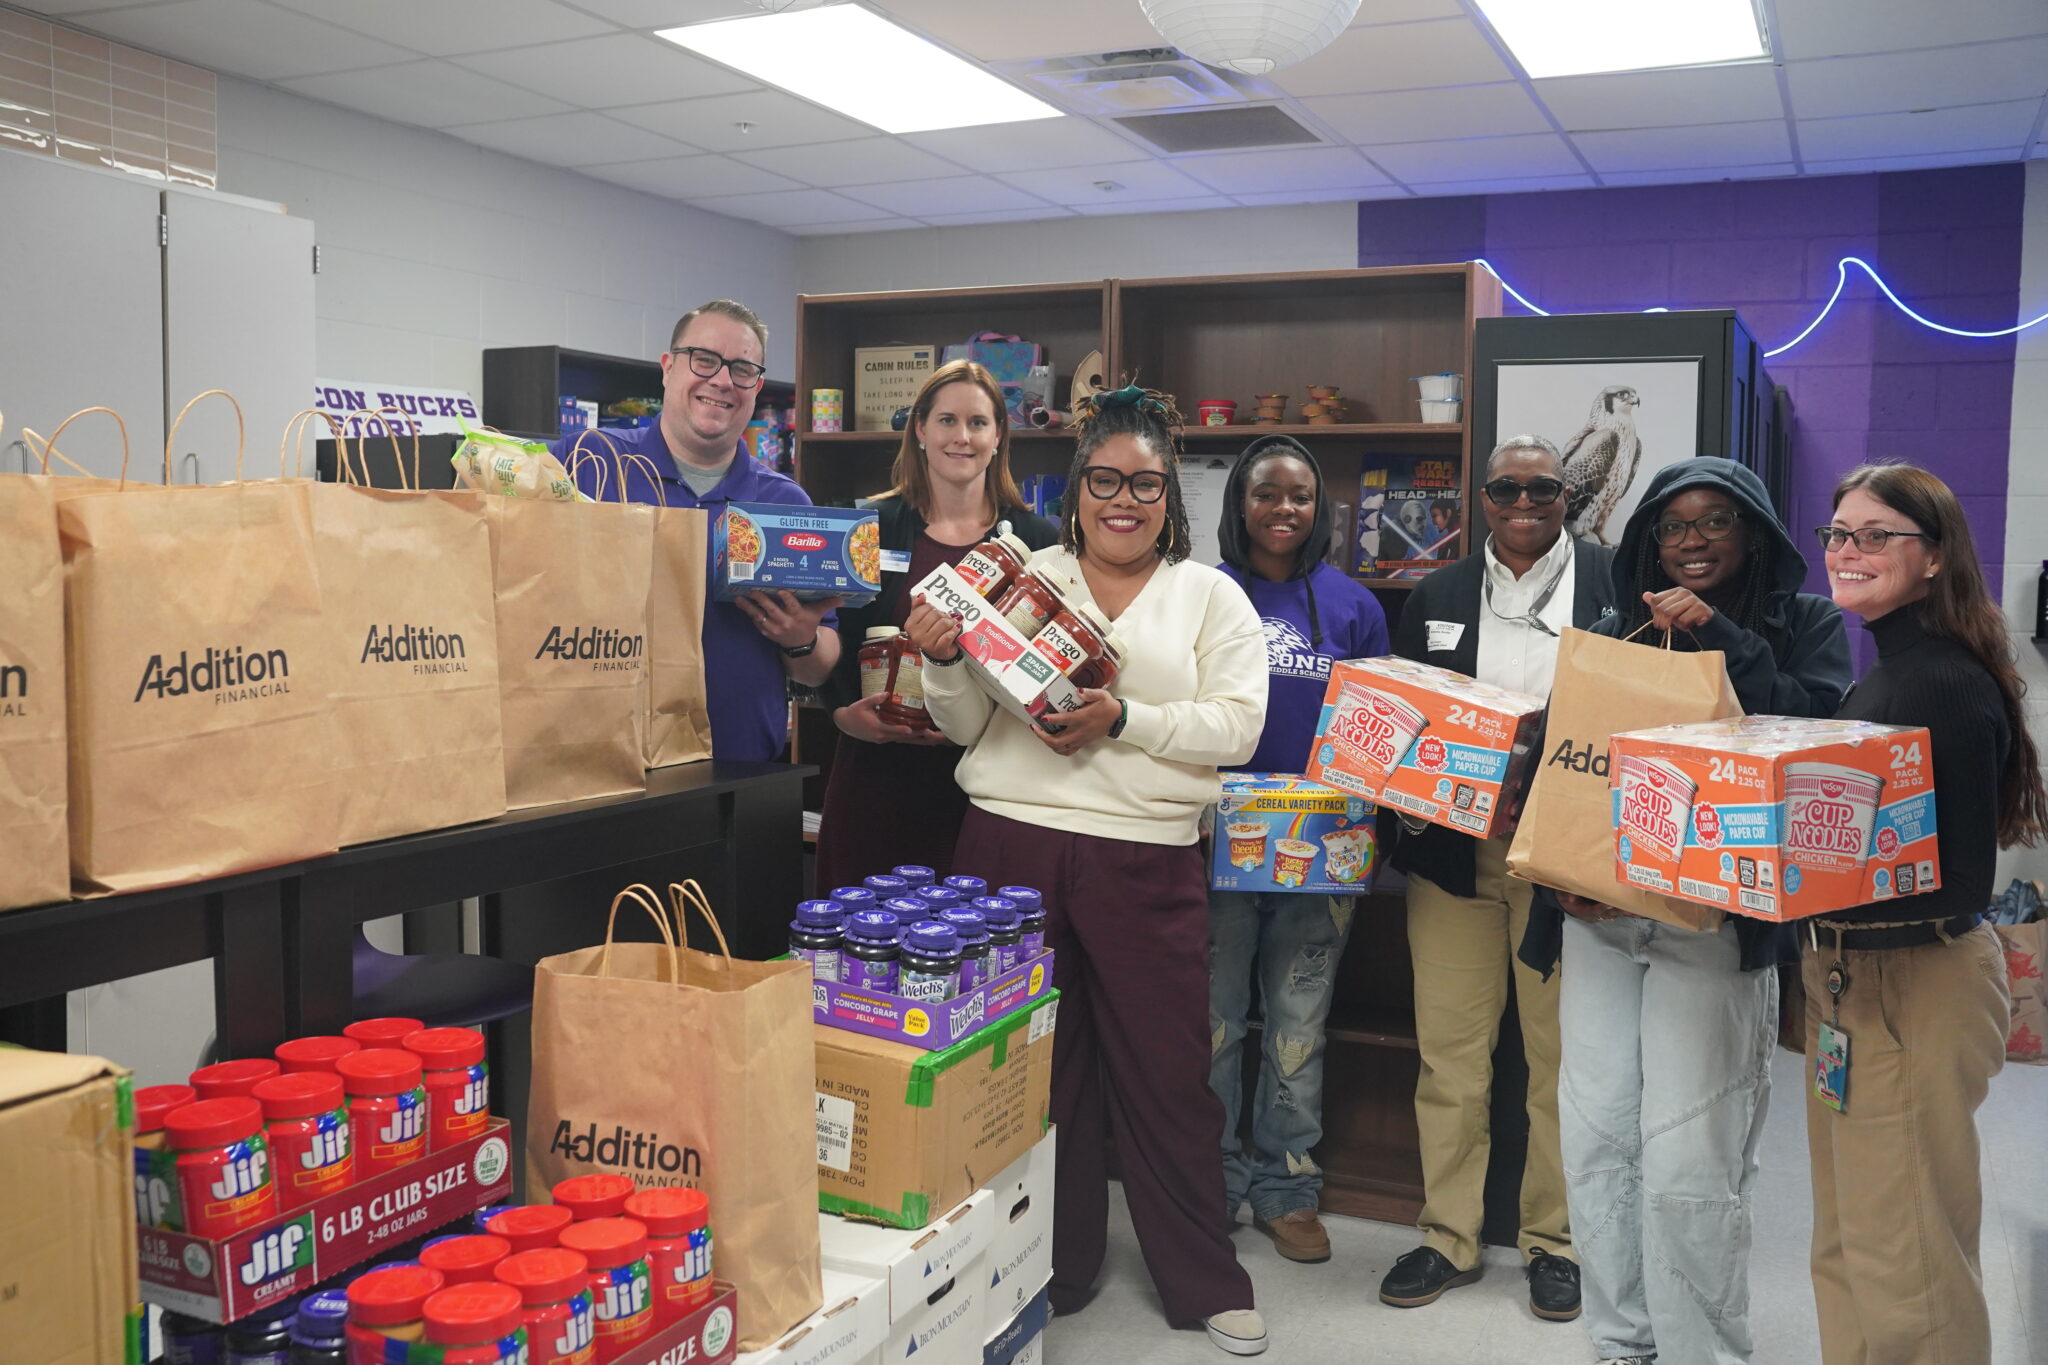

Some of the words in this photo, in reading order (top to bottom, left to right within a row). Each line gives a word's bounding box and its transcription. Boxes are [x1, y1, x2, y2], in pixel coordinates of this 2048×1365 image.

[897, 360, 929, 371] RULES
[377, 392, 477, 419] BUCKS
[1388, 490, 1427, 500] HEAD
[1437, 490, 1462, 500] HEA
[1412, 479, 1456, 488] REBELS
[780, 517, 809, 528] GLUTEN
[812, 519, 829, 529] FREE
[788, 536, 823, 547] Barilla
[799, 554, 809, 568] 4
[961, 553, 997, 578] Prego
[924, 573, 981, 622] Prego
[360, 624, 466, 664] Addition
[535, 625, 643, 661] Addition
[984, 625, 1017, 652] Traditional
[1042, 625, 1081, 660] Prego
[134, 645, 289, 703] Addition
[413, 661, 469, 676] FINANCIAL
[593, 660, 641, 673] FINANCIAL
[1299, 668, 1330, 680] SCHOOL
[214, 681, 291, 706] FINANCIAL
[1351, 707, 1395, 741] CUP
[1445, 704, 1478, 730] 24
[1480, 716, 1503, 729] PACK
[1330, 714, 1396, 766] NOODLES
[1477, 725, 1494, 736] 2.25
[1494, 729, 1508, 740] OZ
[1332, 737, 1369, 764] CHICKEN
[1421, 751, 1442, 762] LOOK!
[1424, 743, 1441, 753] NEW
[1451, 749, 1502, 767] MICROWAVABLE
[1889, 741, 1923, 770] 24
[1454, 760, 1479, 774] PAPER
[1480, 764, 1497, 777] CUP
[1708, 756, 1737, 785] 24
[1737, 764, 1759, 777] PACK
[1895, 767, 1920, 779] PACK
[1737, 776, 1754, 788] 2.25
[1754, 778, 1767, 790] OZ
[1822, 782, 1844, 793] NISSIN
[1892, 778, 1910, 789] 2.25
[1911, 776, 1924, 786] OZ
[1256, 798, 1288, 810] CEREAL
[1288, 799, 1323, 811] VARIETY
[1324, 799, 1346, 811] PACK
[1350, 801, 1362, 812] 12
[1635, 782, 1673, 818] CUP
[1622, 795, 1678, 848] NOODLES
[1699, 811, 1713, 822] NEW
[1723, 812, 1769, 826] MICROWAVABLE
[1805, 799, 1855, 829] CUP
[1893, 813, 1914, 827] PAPER
[1913, 810, 1926, 822] CUP
[1626, 826, 1659, 852] CHICKEN
[1729, 826, 1752, 840] PAPER
[1752, 826, 1767, 839] CUP
[1788, 819, 1862, 855] NOODLES
[1880, 832, 1893, 842] NEW
[1231, 843, 1263, 855] Cheerios
[1880, 840, 1896, 851] LOOK!
[1794, 851, 1838, 866] CHICKEN
[904, 982, 943, 997] Welch's
[987, 987, 1012, 1006] CONCORD
[1011, 979, 1027, 994] GRAPE
[834, 997, 871, 1012] CONCORD
[872, 1007, 899, 1020] GRAPE
[855, 1013, 876, 1023] JELLY
[908, 1014, 926, 1023] Value
[950, 994, 983, 1036] Welch's
[908, 1020, 926, 1029] Pack
[454, 1074, 489, 1115] Jif
[821, 1079, 834, 1090] IN
[837, 1082, 870, 1098] MADE
[380, 1101, 426, 1144] Jif
[301, 1122, 350, 1170] Jif
[549, 1119, 702, 1178] Addition
[819, 1149, 828, 1161] 36
[211, 1149, 267, 1200] Jif
[135, 1173, 171, 1227] if
[321, 1216, 336, 1244] 6
[340, 1205, 364, 1236] LB
[368, 1181, 423, 1222] CLUB
[425, 1162, 468, 1199] SIZE
[367, 1223, 390, 1245] 2-48
[390, 1217, 405, 1233] OZ
[405, 1206, 429, 1228] JARS
[240, 1223, 305, 1287] Jif
[673, 1239, 714, 1284] Jif
[1001, 1261, 1016, 1280] IRON
[1014, 1232, 1043, 1265] MOUNTAIN
[253, 1272, 297, 1300] CREAMY
[595, 1275, 648, 1321] Jif
[555, 1300, 595, 1355] Jif
[919, 1324, 938, 1348] IRON
[936, 1295, 973, 1335] MOUNTAIN
[660, 1335, 698, 1365] SIZE
